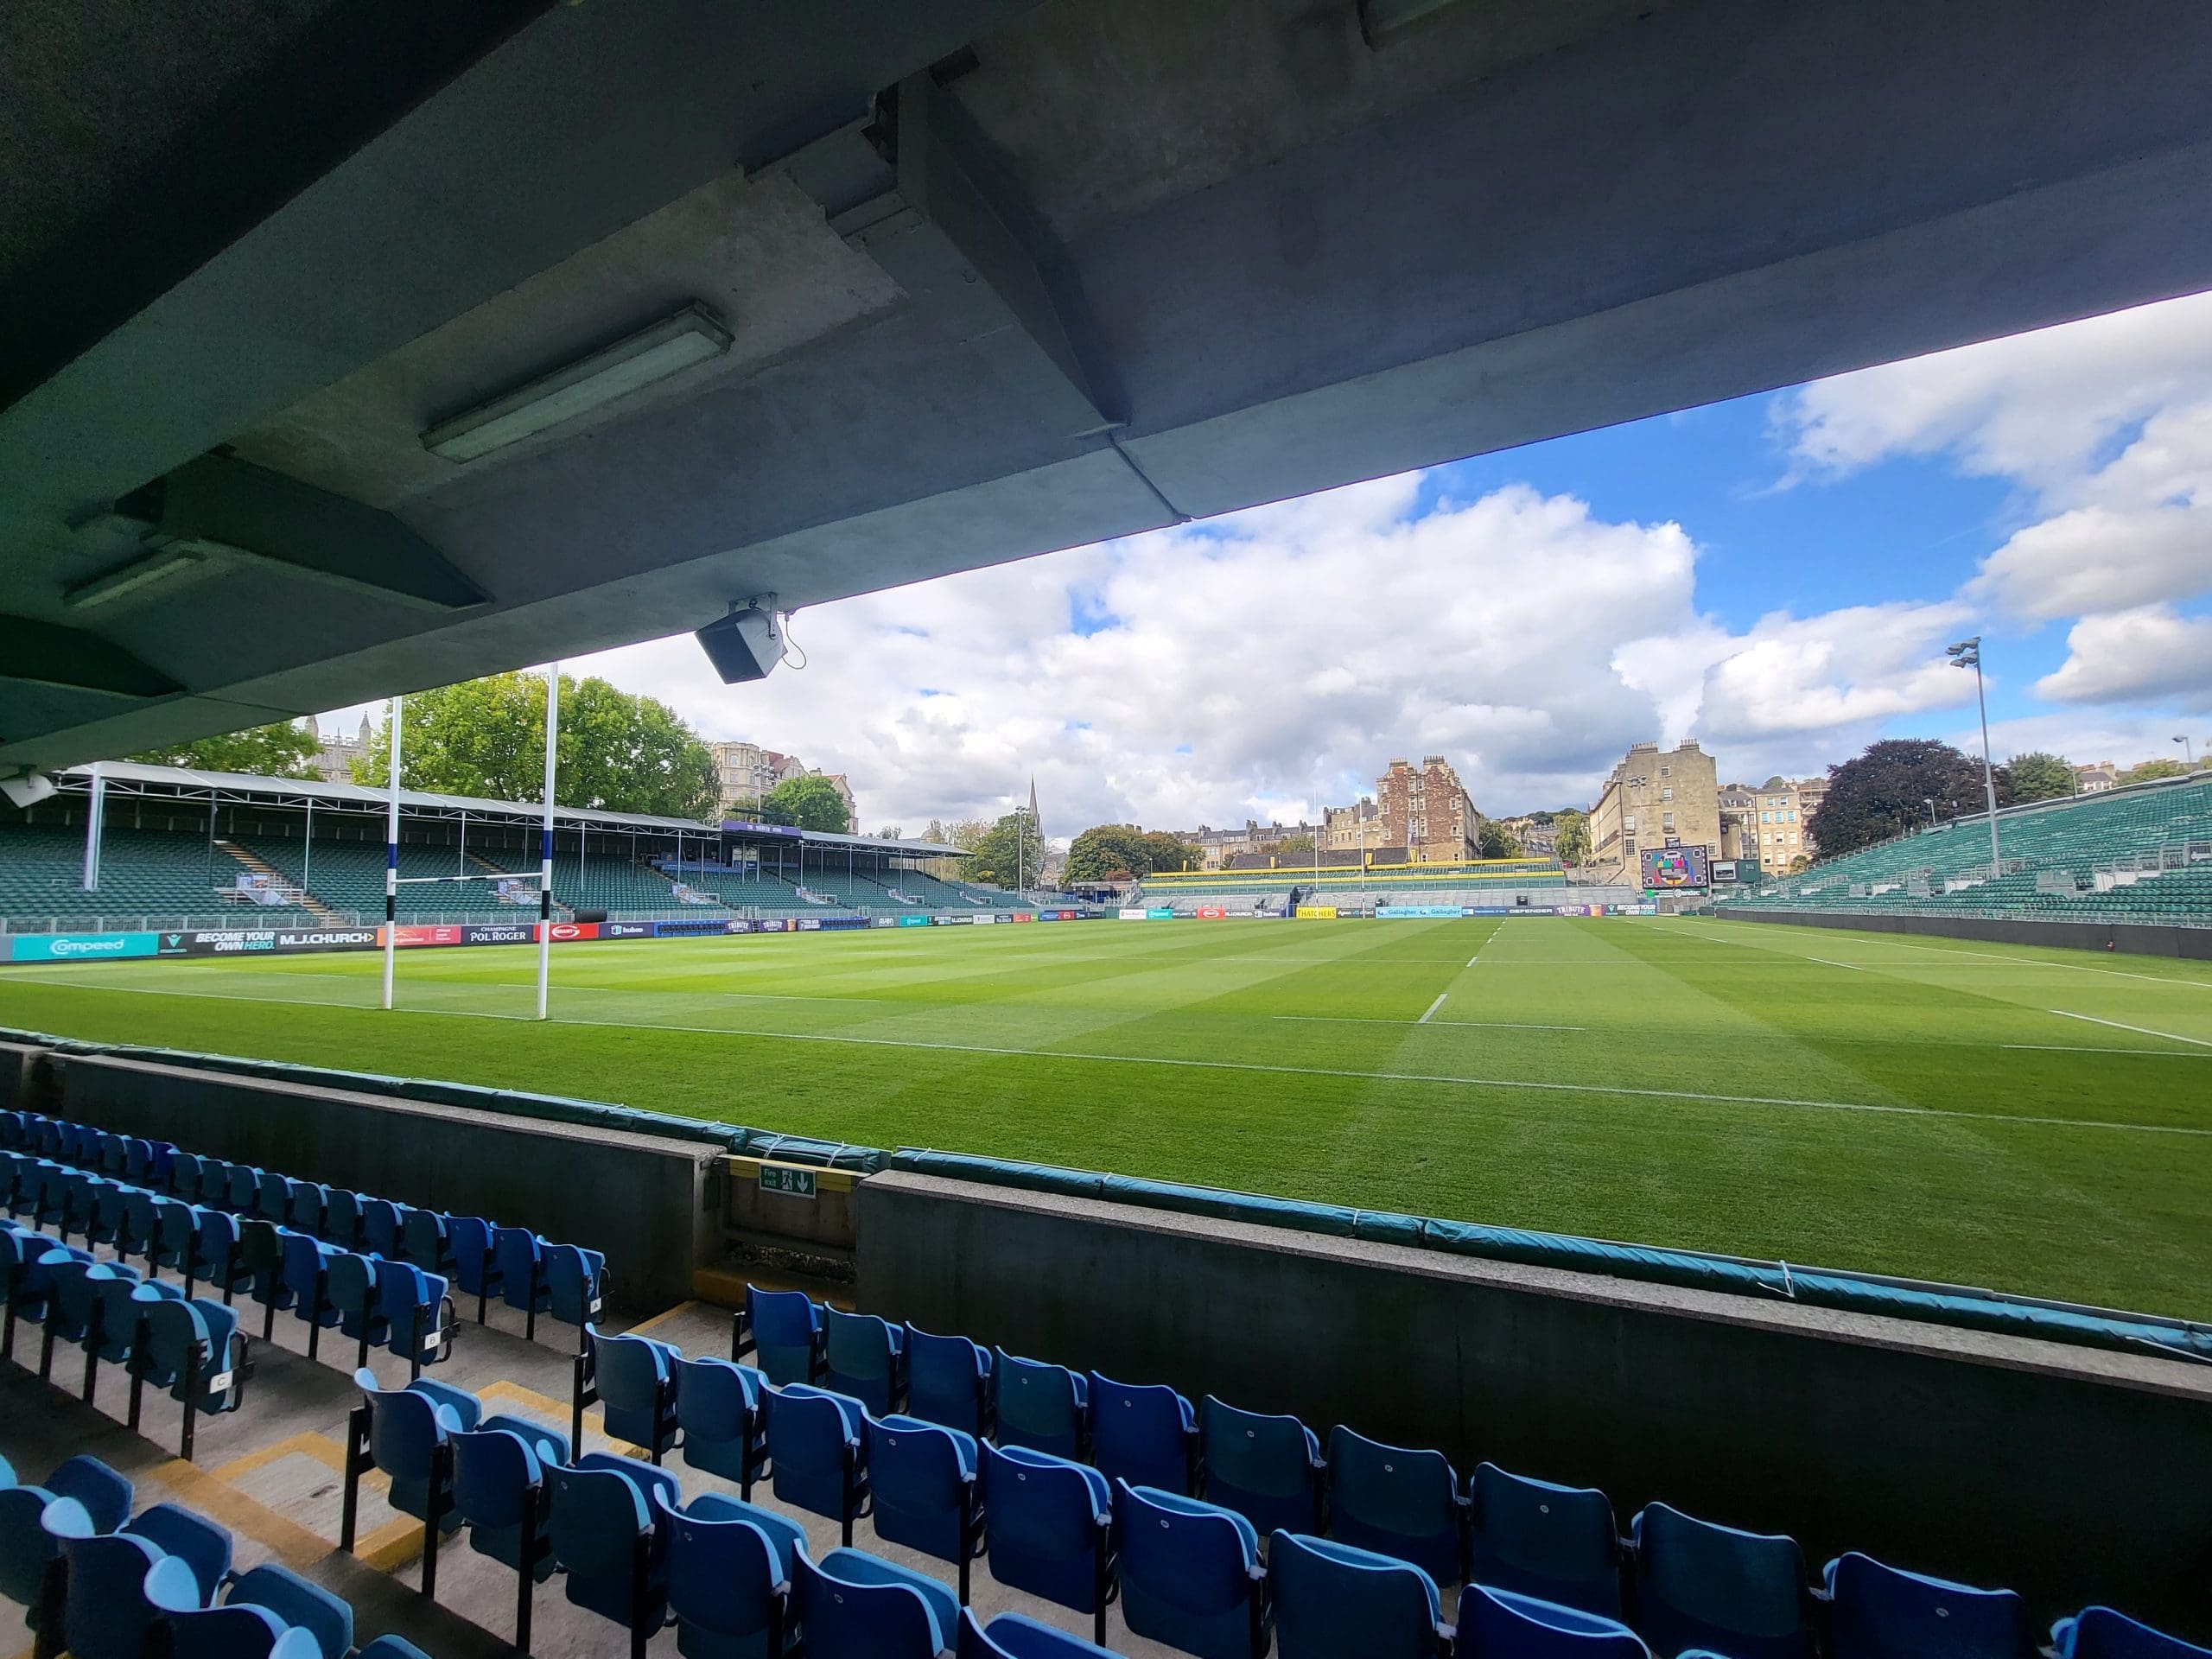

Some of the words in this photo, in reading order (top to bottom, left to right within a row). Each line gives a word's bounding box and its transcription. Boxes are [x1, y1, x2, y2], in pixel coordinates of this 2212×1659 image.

[1298, 909, 1336, 918] THATCHERS
[728, 921, 749, 930] TRIBUTE
[763, 920, 783, 929] TRIBUTE
[195, 933, 245, 943] BECOME
[245, 931, 276, 941] YOUR
[470, 931, 491, 942] POL
[492, 931, 526, 940] ROGER
[50, 938, 125, 956] Compeed
[214, 942, 243, 951] OWN
[764, 1168, 777, 1178] Fire
[764, 1179, 777, 1187] exit
[217, 1376, 226, 1387] C
